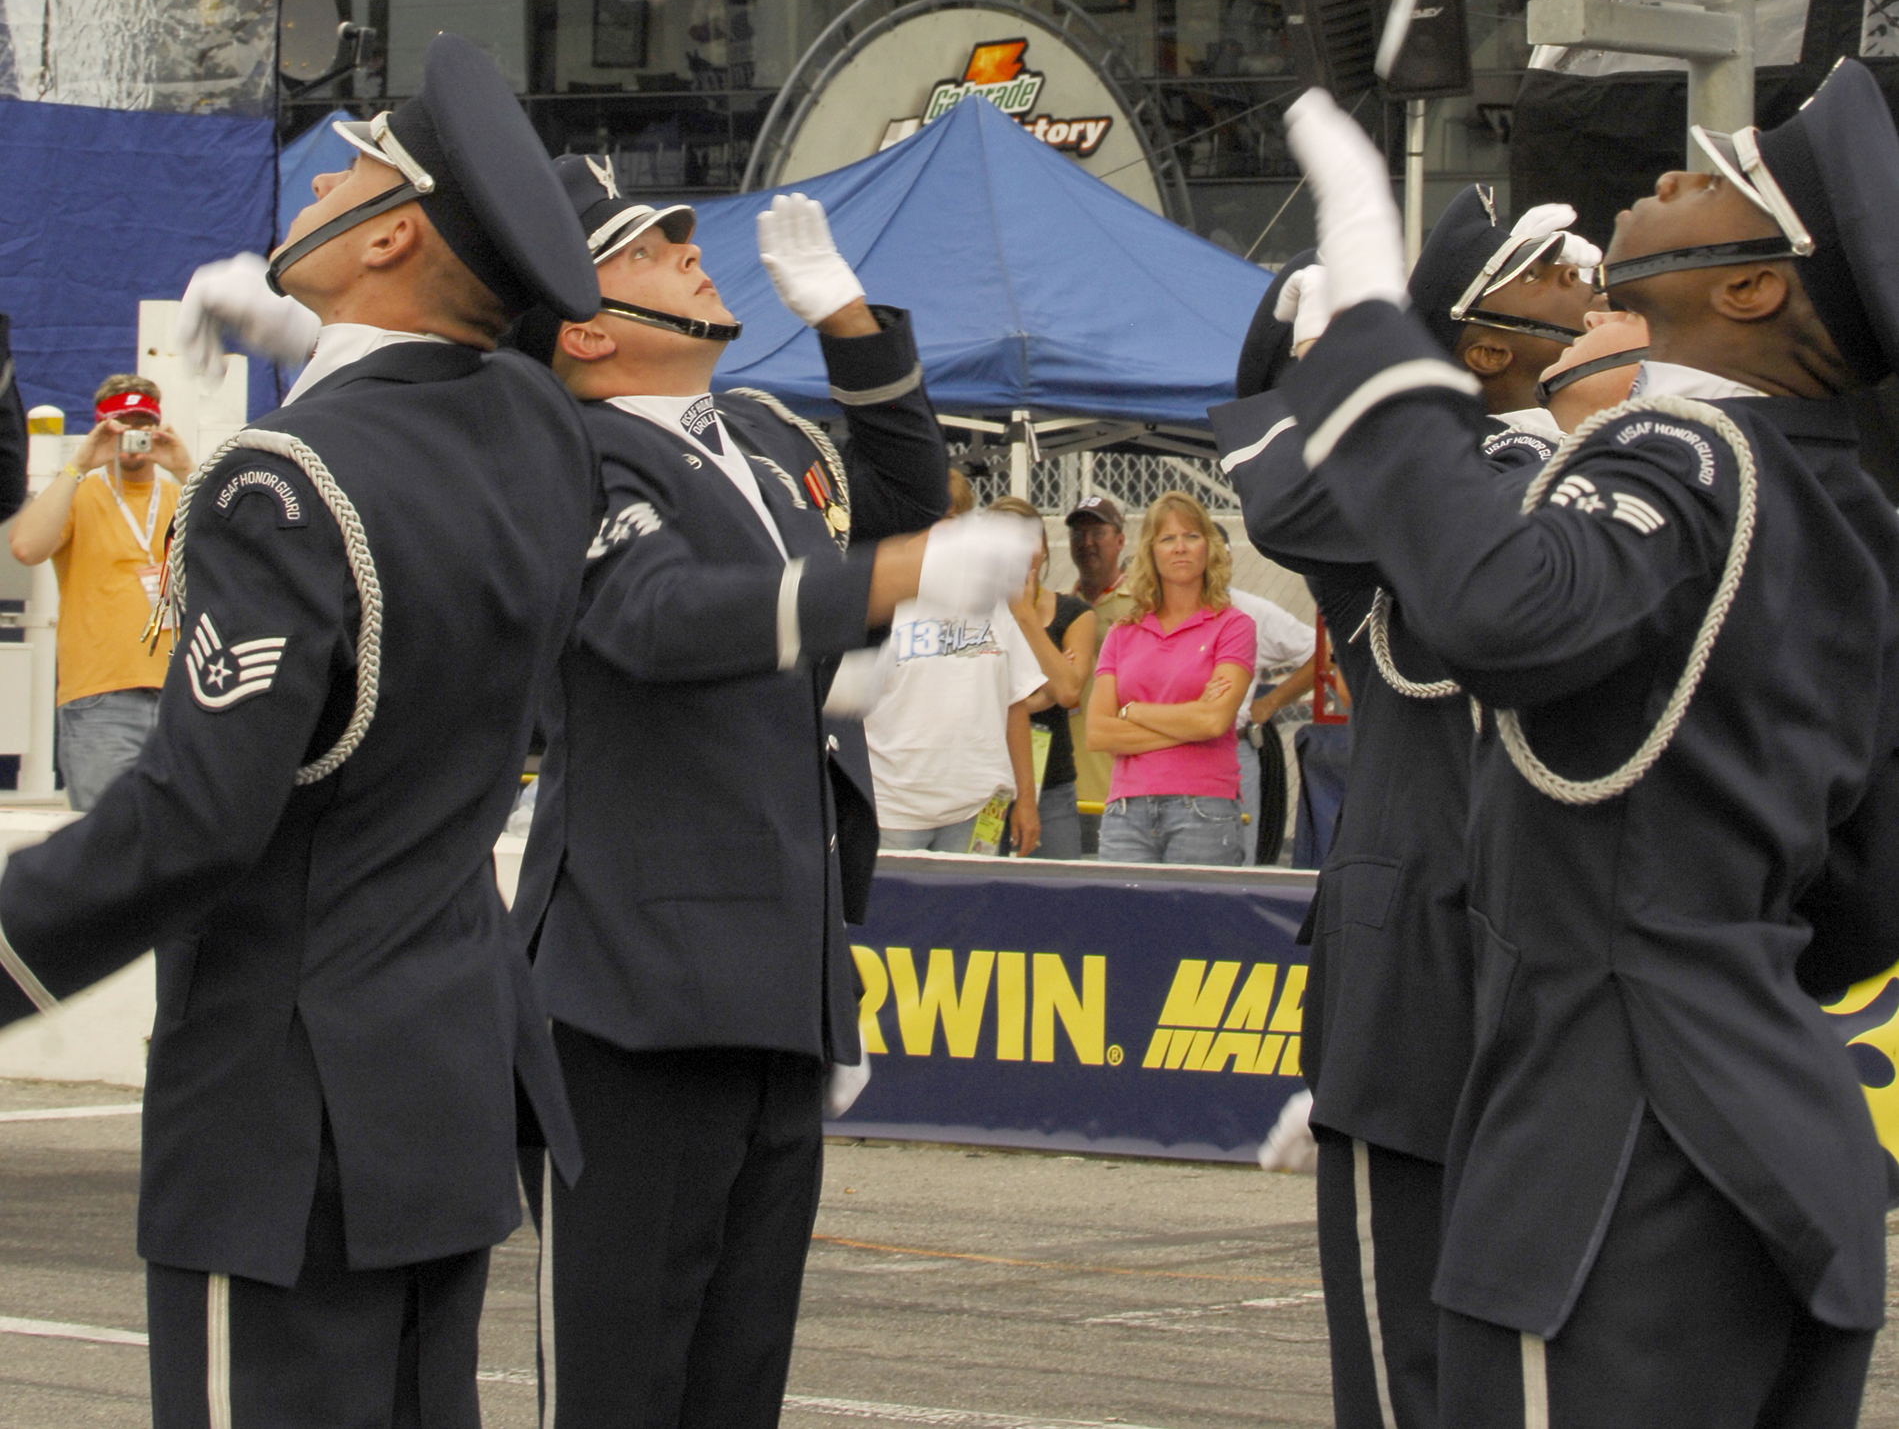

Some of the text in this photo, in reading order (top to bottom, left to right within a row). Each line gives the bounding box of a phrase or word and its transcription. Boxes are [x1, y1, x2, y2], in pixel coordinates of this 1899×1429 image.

[928, 79, 1038, 121] Garade
[1023, 117, 1110, 150] tory
[1484, 437, 1514, 456] USAF
[1513, 435, 1547, 451] HONOR
[1616, 421, 1715, 486] USAF HONOR GUARD
[217, 471, 301, 520] USAF HONOR GUARD
[895, 618, 942, 663] 13
[850, 944, 1107, 1066] RWIN
